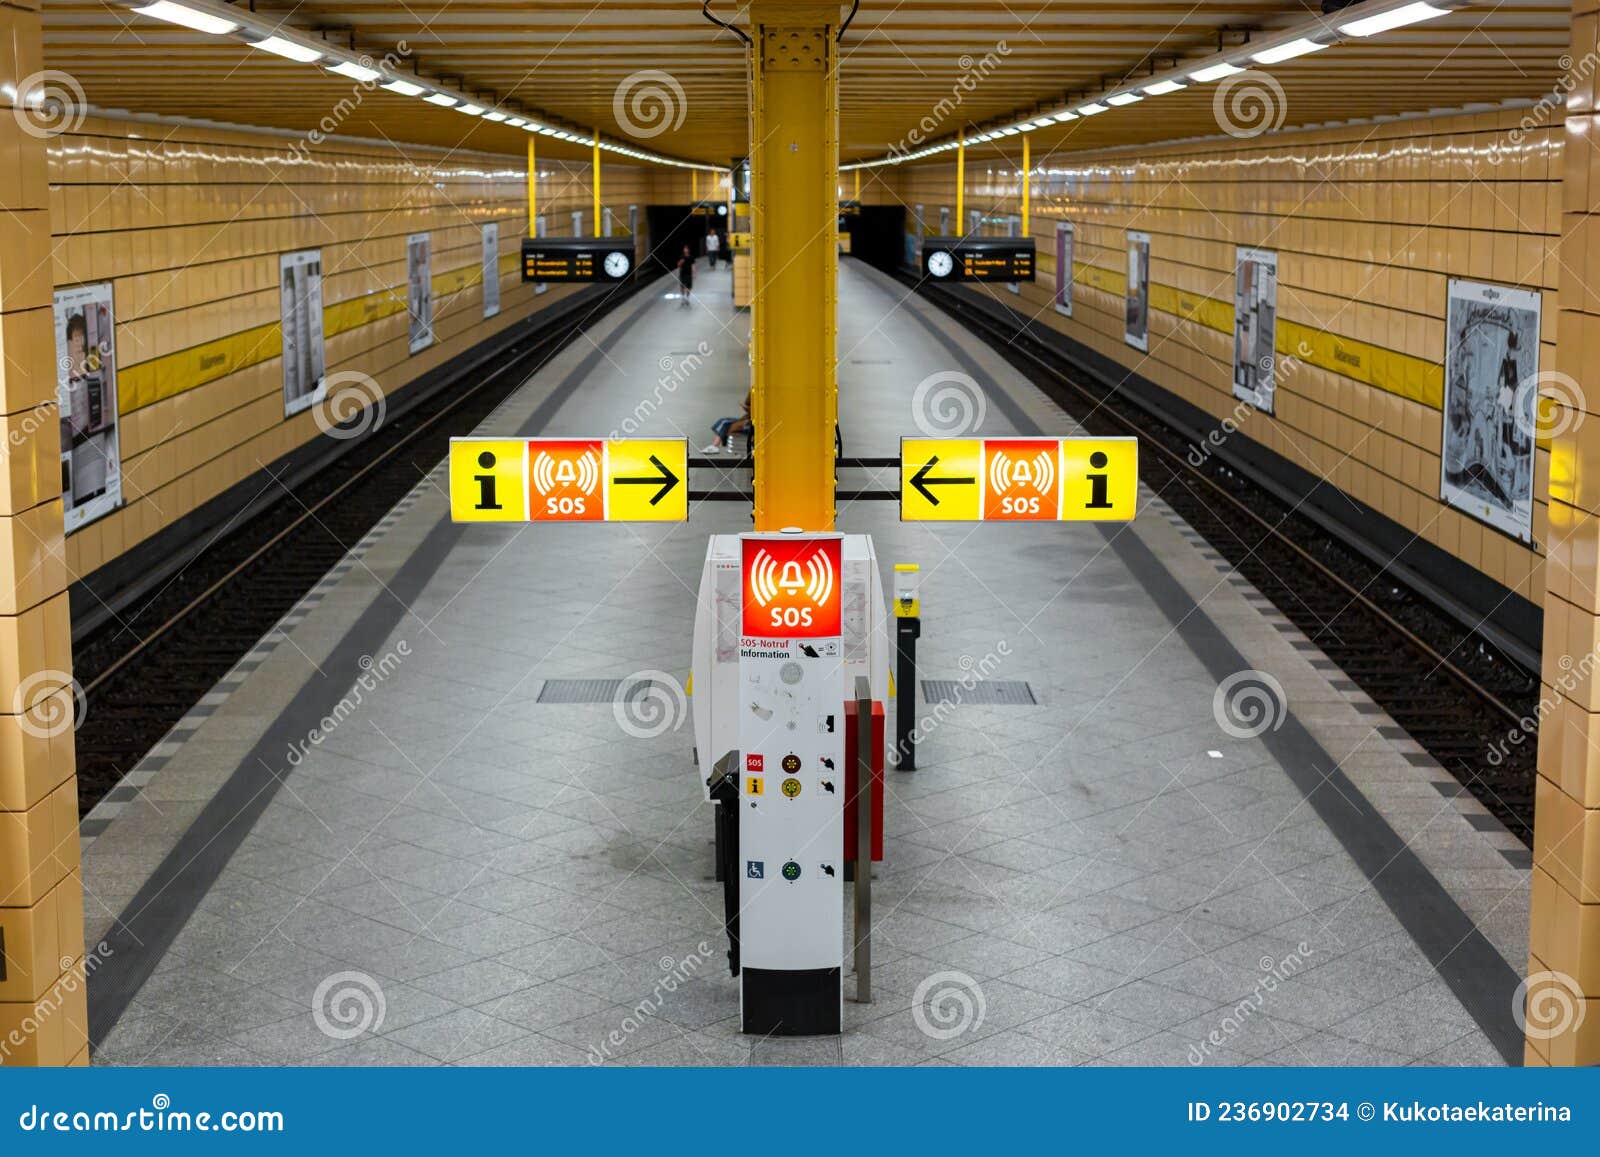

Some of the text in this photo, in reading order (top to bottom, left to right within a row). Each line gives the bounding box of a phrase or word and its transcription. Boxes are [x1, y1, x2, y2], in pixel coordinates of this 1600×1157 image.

[547, 496, 586, 515] SOS
[1001, 496, 1040, 514] SOS
[770, 607, 813, 628] SOS
[740, 638, 790, 649] SOS-Notruf
[740, 649, 790, 660] Information
[748, 759, 762, 767] SOS
